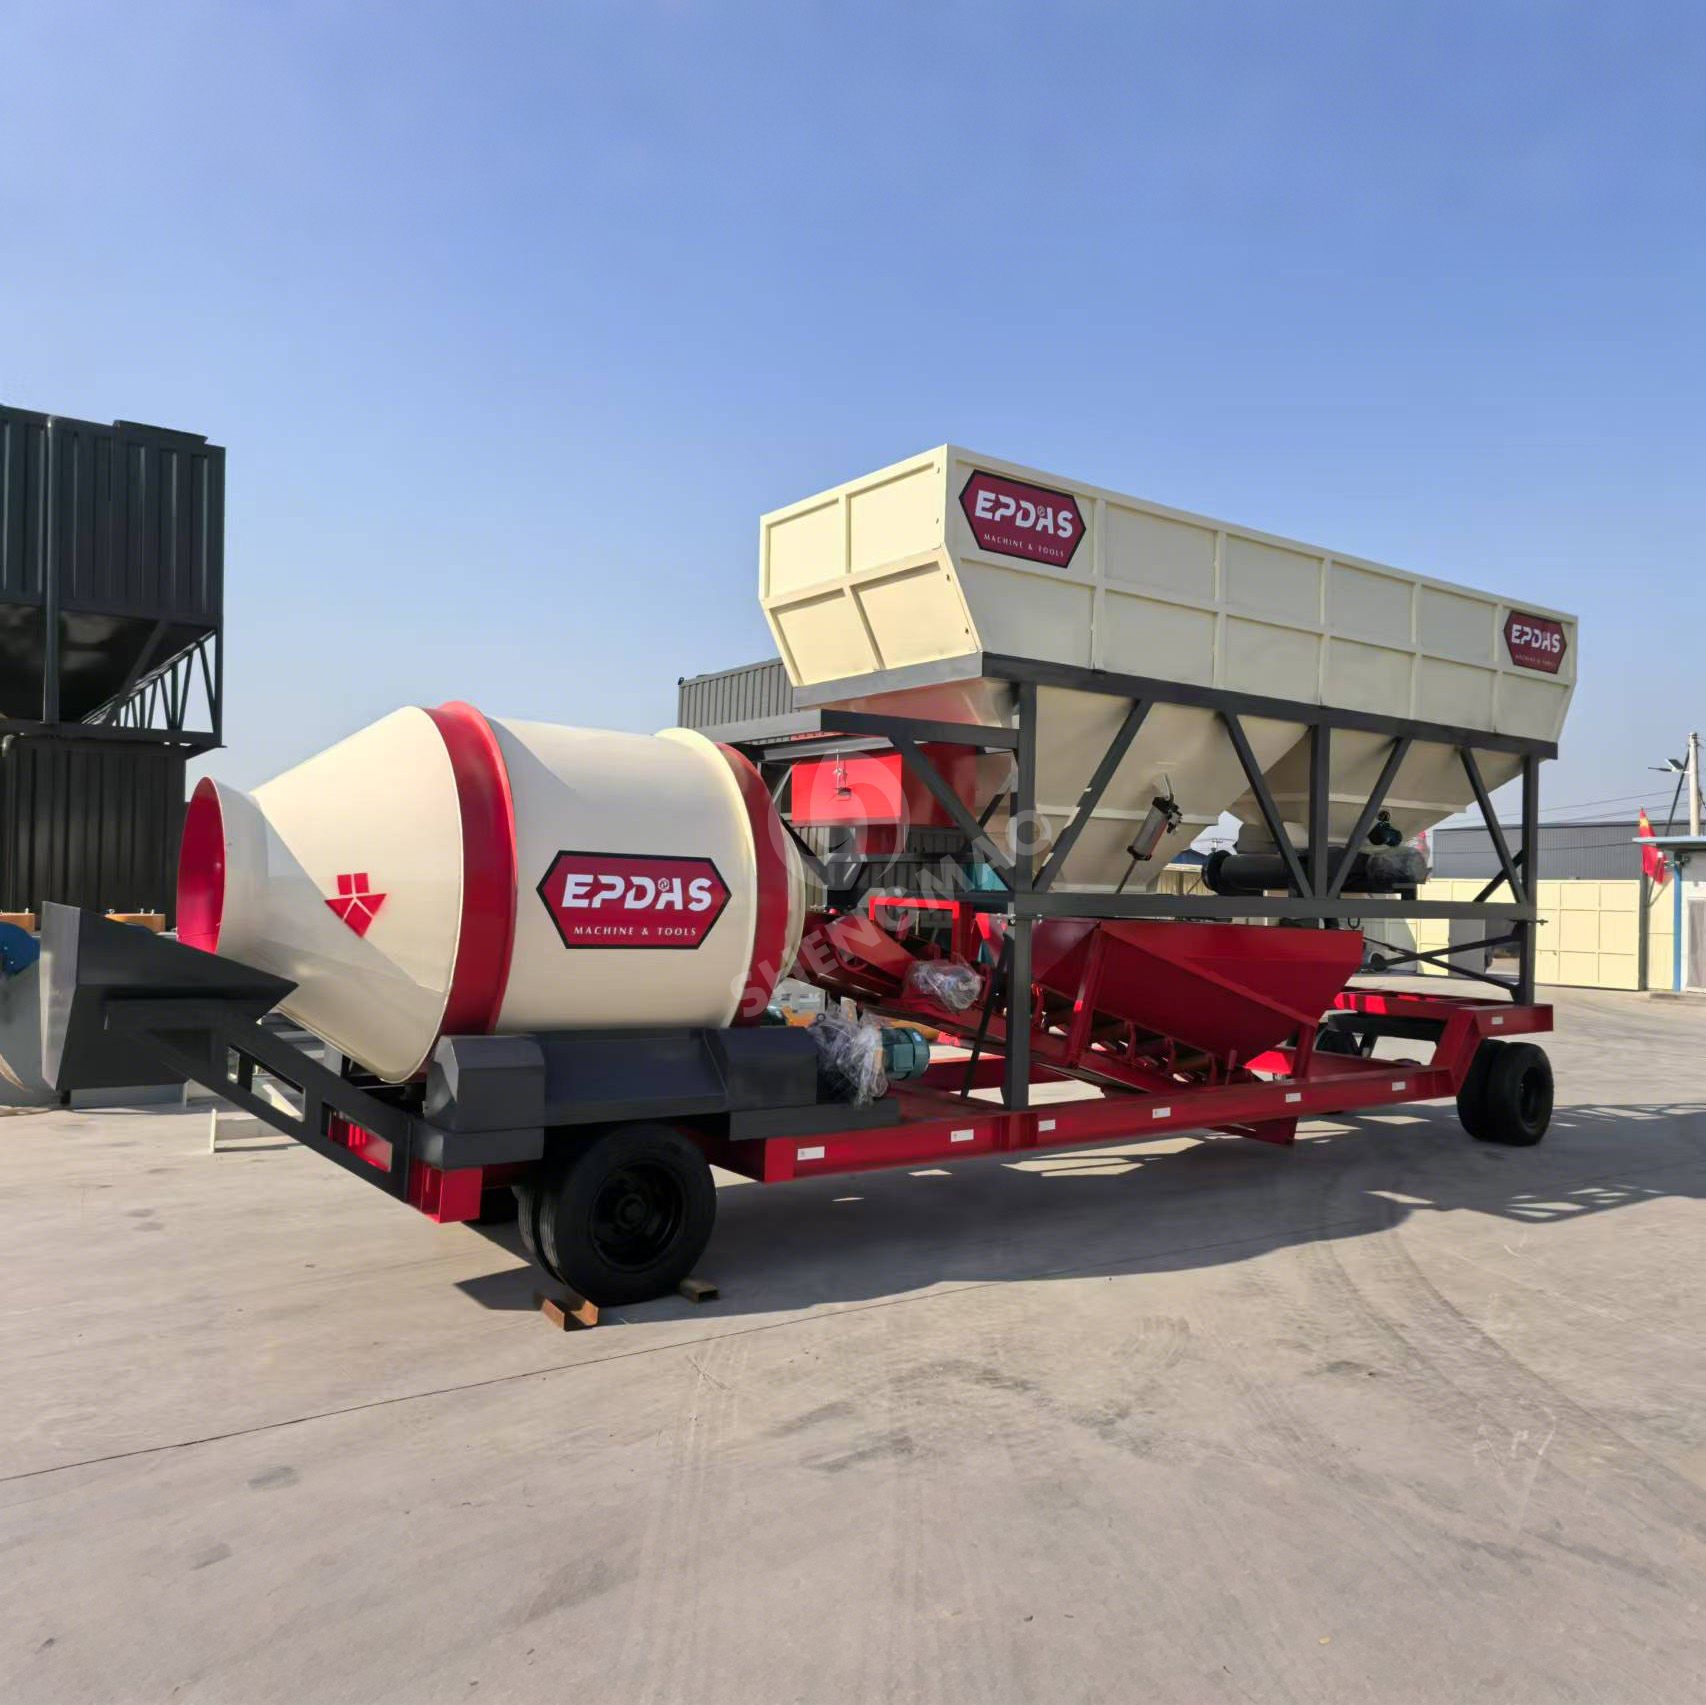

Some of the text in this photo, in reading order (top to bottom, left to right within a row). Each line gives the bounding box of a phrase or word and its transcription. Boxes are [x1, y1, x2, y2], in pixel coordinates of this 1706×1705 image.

[975, 490, 1073, 538] EPDAS
[983, 533, 1024, 548] MACHINE
[1038, 545, 1065, 558] TOOLS
[1511, 624, 1560, 653] EPDAS
[561, 873, 713, 912] EPDAS
[574, 926, 697, 936] MACHINE & TOOLS
